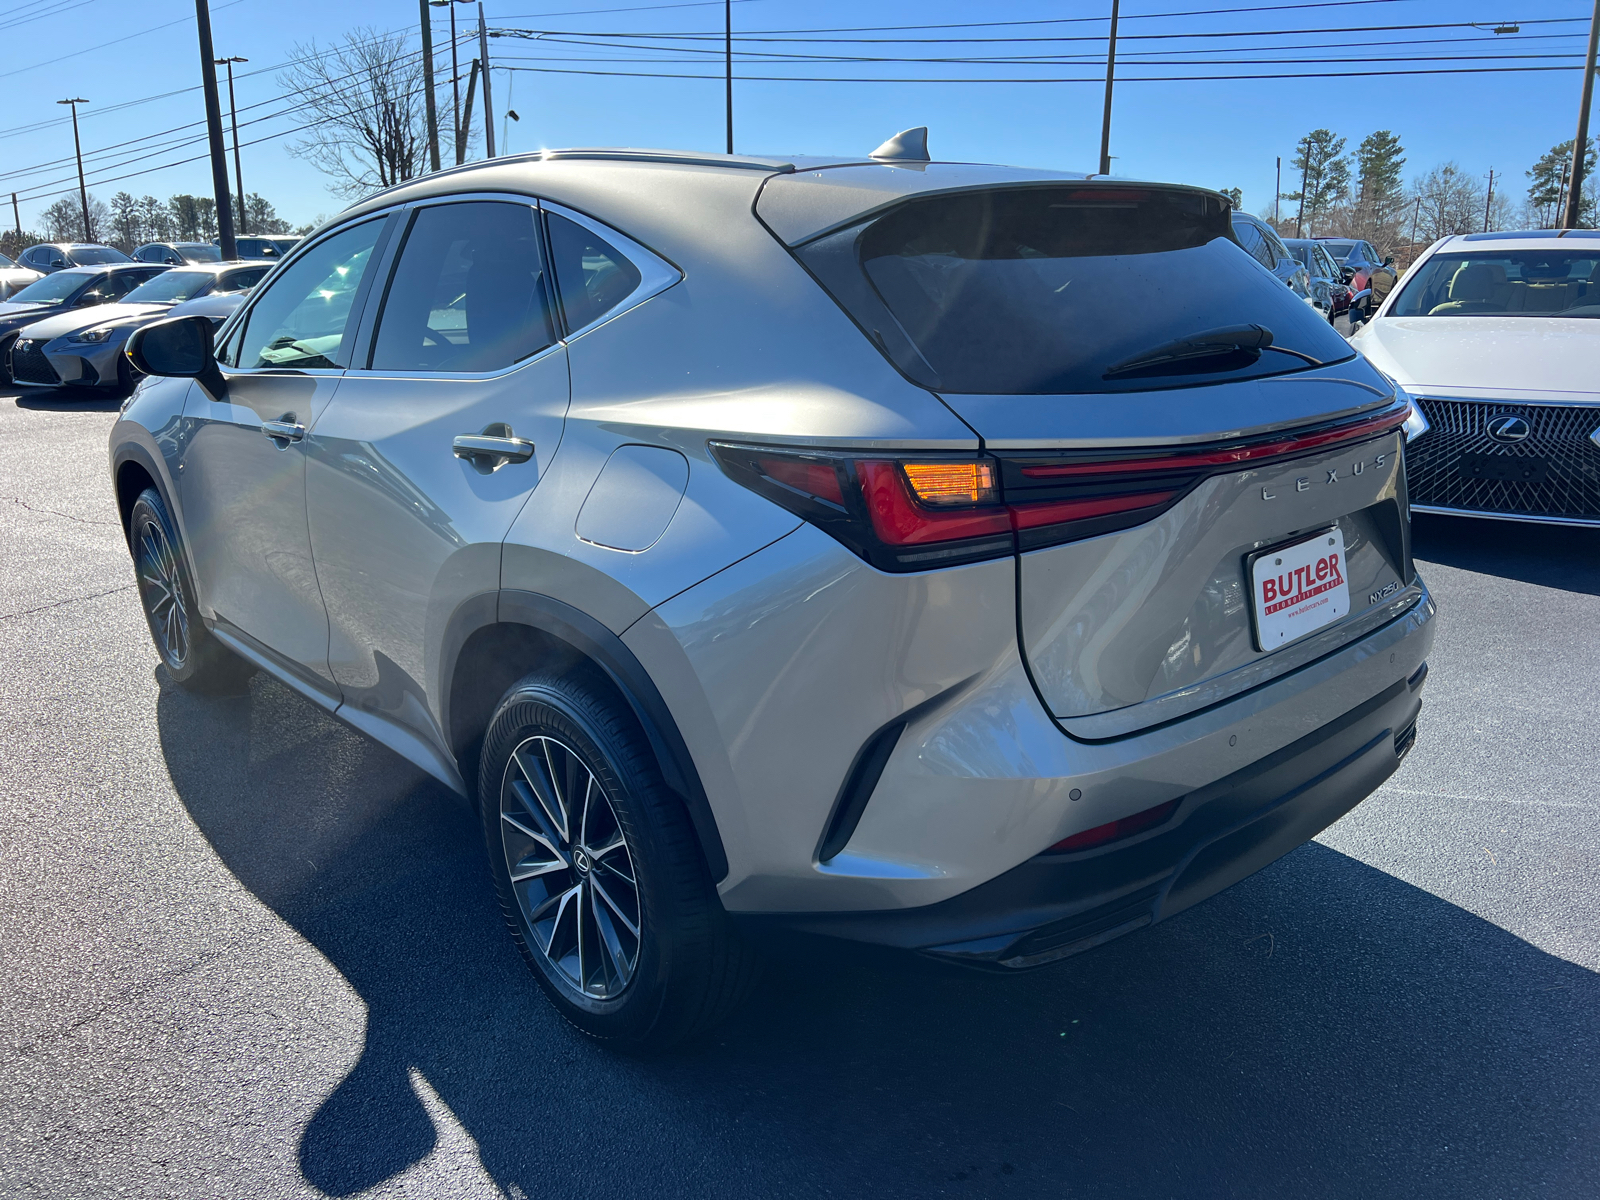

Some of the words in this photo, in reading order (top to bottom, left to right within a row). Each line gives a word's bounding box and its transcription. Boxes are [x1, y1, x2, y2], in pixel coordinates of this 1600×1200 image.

[1262, 454, 1385, 500] LEXUS
[1265, 589, 1315, 615] AUTOMOTIVE
[1321, 576, 1343, 592] GROUP
[1288, 597, 1329, 619] www.butlercars.com
[1368, 581, 1399, 604] NX250
